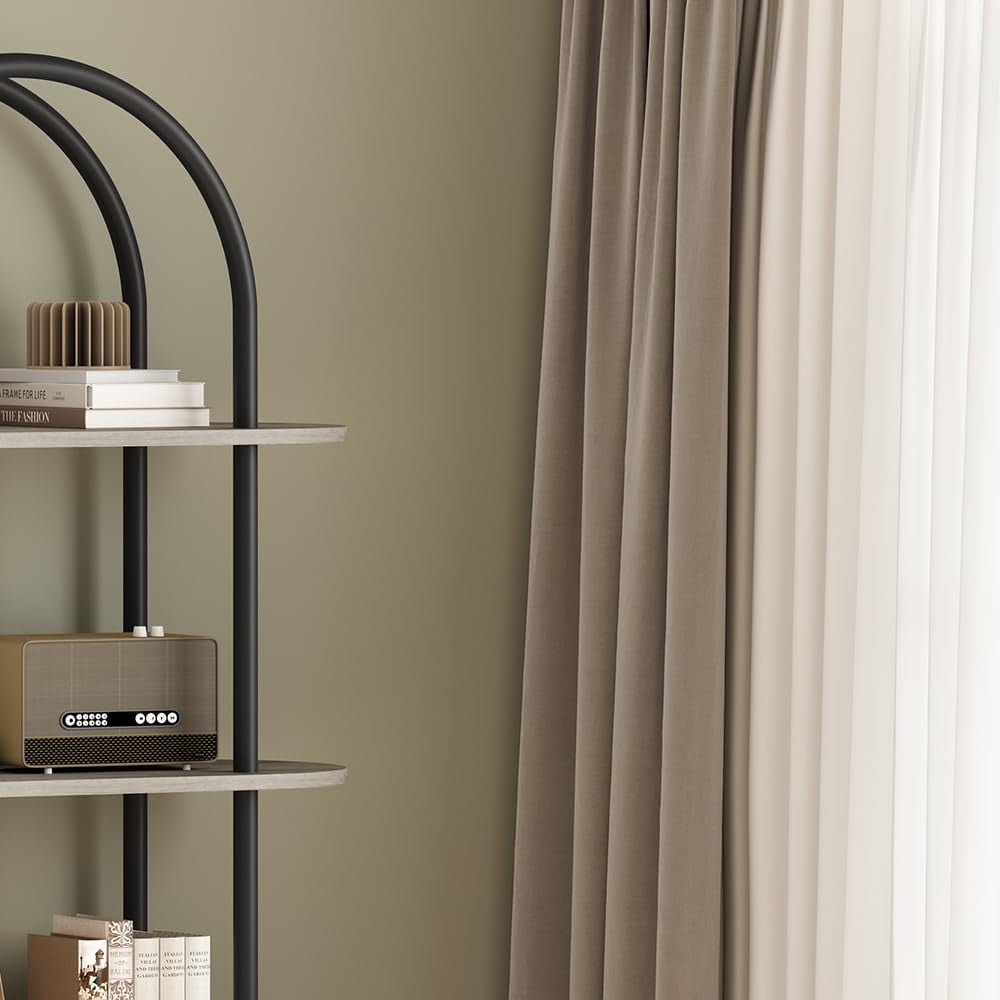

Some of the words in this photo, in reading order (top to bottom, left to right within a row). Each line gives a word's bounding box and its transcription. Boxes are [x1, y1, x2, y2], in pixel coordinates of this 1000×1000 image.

[2, 389, 21, 399] FRAME
[22, 389, 33, 400] FOR
[34, 390, 46, 400] LIFE
[1, 410, 16, 422] THE
[17, 410, 49, 423] FASHION
